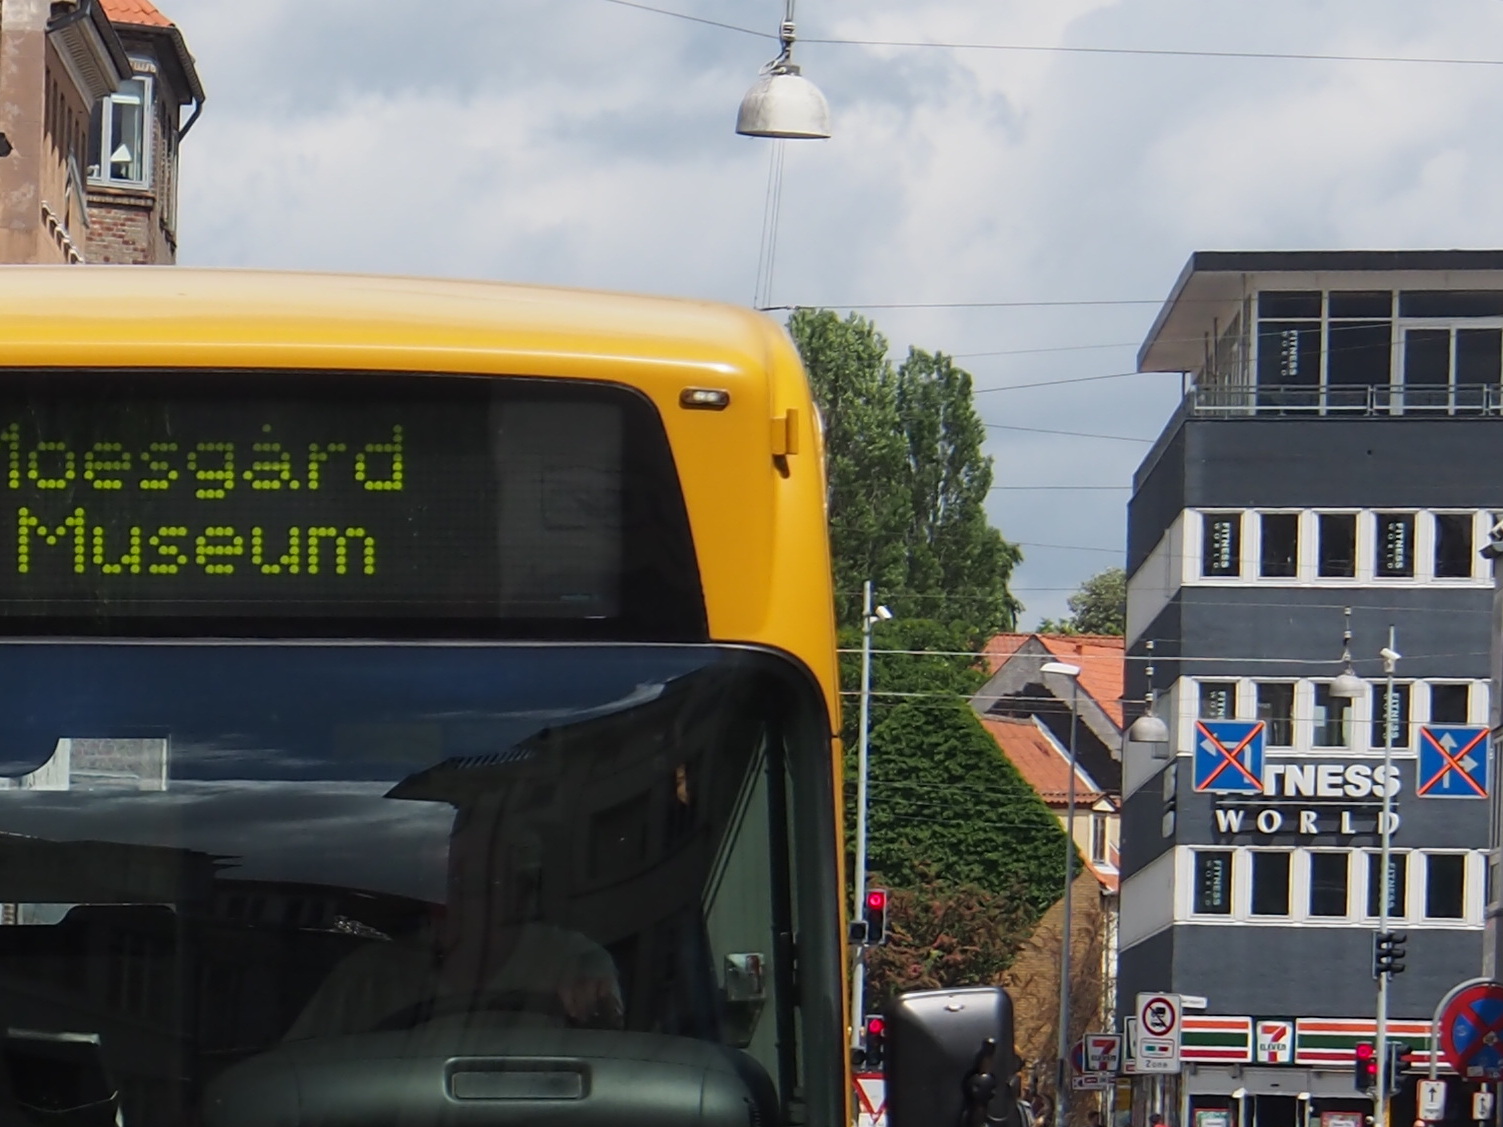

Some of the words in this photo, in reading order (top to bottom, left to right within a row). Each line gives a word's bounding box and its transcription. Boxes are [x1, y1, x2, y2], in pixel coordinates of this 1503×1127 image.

[17, 506, 376, 575] Museum
[1221, 522, 1230, 568] FITNESS
[1395, 522, 1404, 569] FITNESS
[1262, 764, 1401, 797] TNESS
[1215, 809, 1401, 834] WORLD
[1145, 1060, 1168, 1069] Zone
